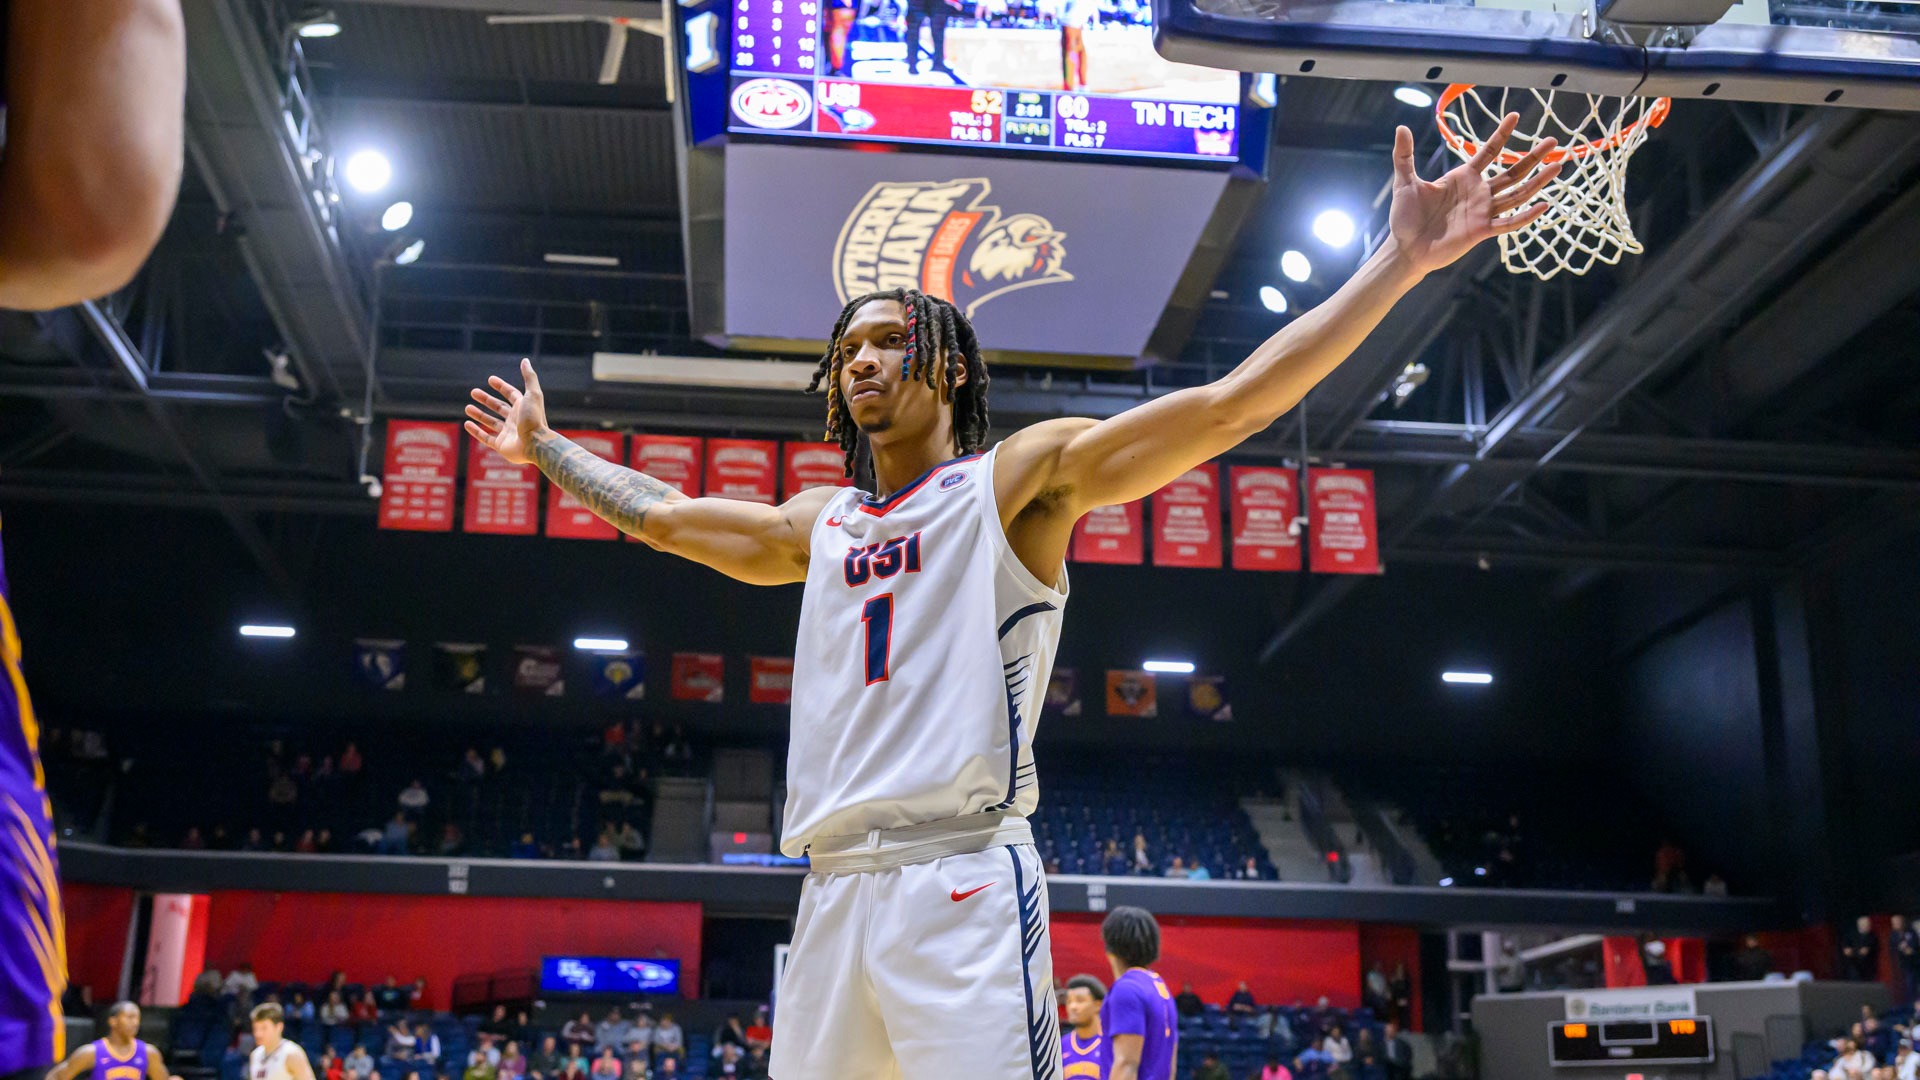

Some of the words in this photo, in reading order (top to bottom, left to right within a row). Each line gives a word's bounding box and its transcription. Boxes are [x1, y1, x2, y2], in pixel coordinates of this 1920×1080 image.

[818, 82, 860, 107] USI
[971, 89, 1002, 114] 52
[1057, 94, 1090, 119] 60
[1131, 101, 1166, 126] TN
[1168, 103, 1235, 130] TECH
[843, 187, 920, 299] UTHERN
[877, 184, 970, 291] DIANA
[843, 531, 922, 588] USI
[861, 592, 894, 687] 1
